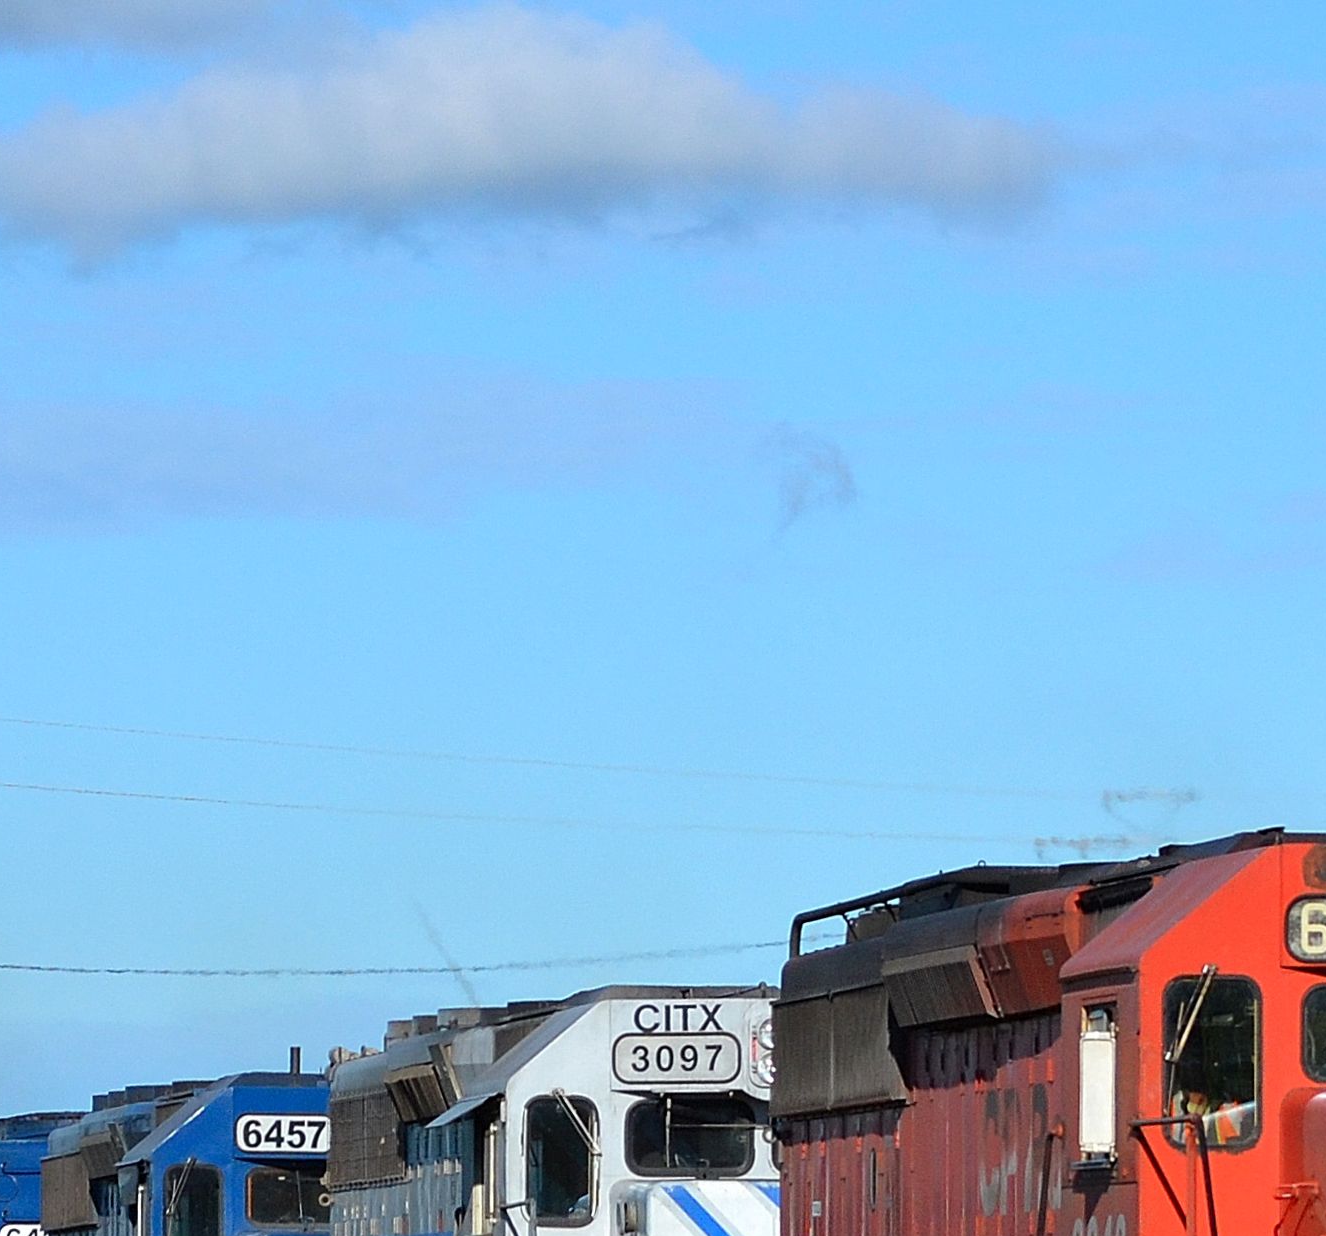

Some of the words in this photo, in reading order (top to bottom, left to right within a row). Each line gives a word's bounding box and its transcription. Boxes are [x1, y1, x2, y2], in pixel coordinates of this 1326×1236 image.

[633, 1003, 723, 1033] CITX
[631, 1044, 723, 1072] 3097
[243, 1119, 327, 1149] 6457
